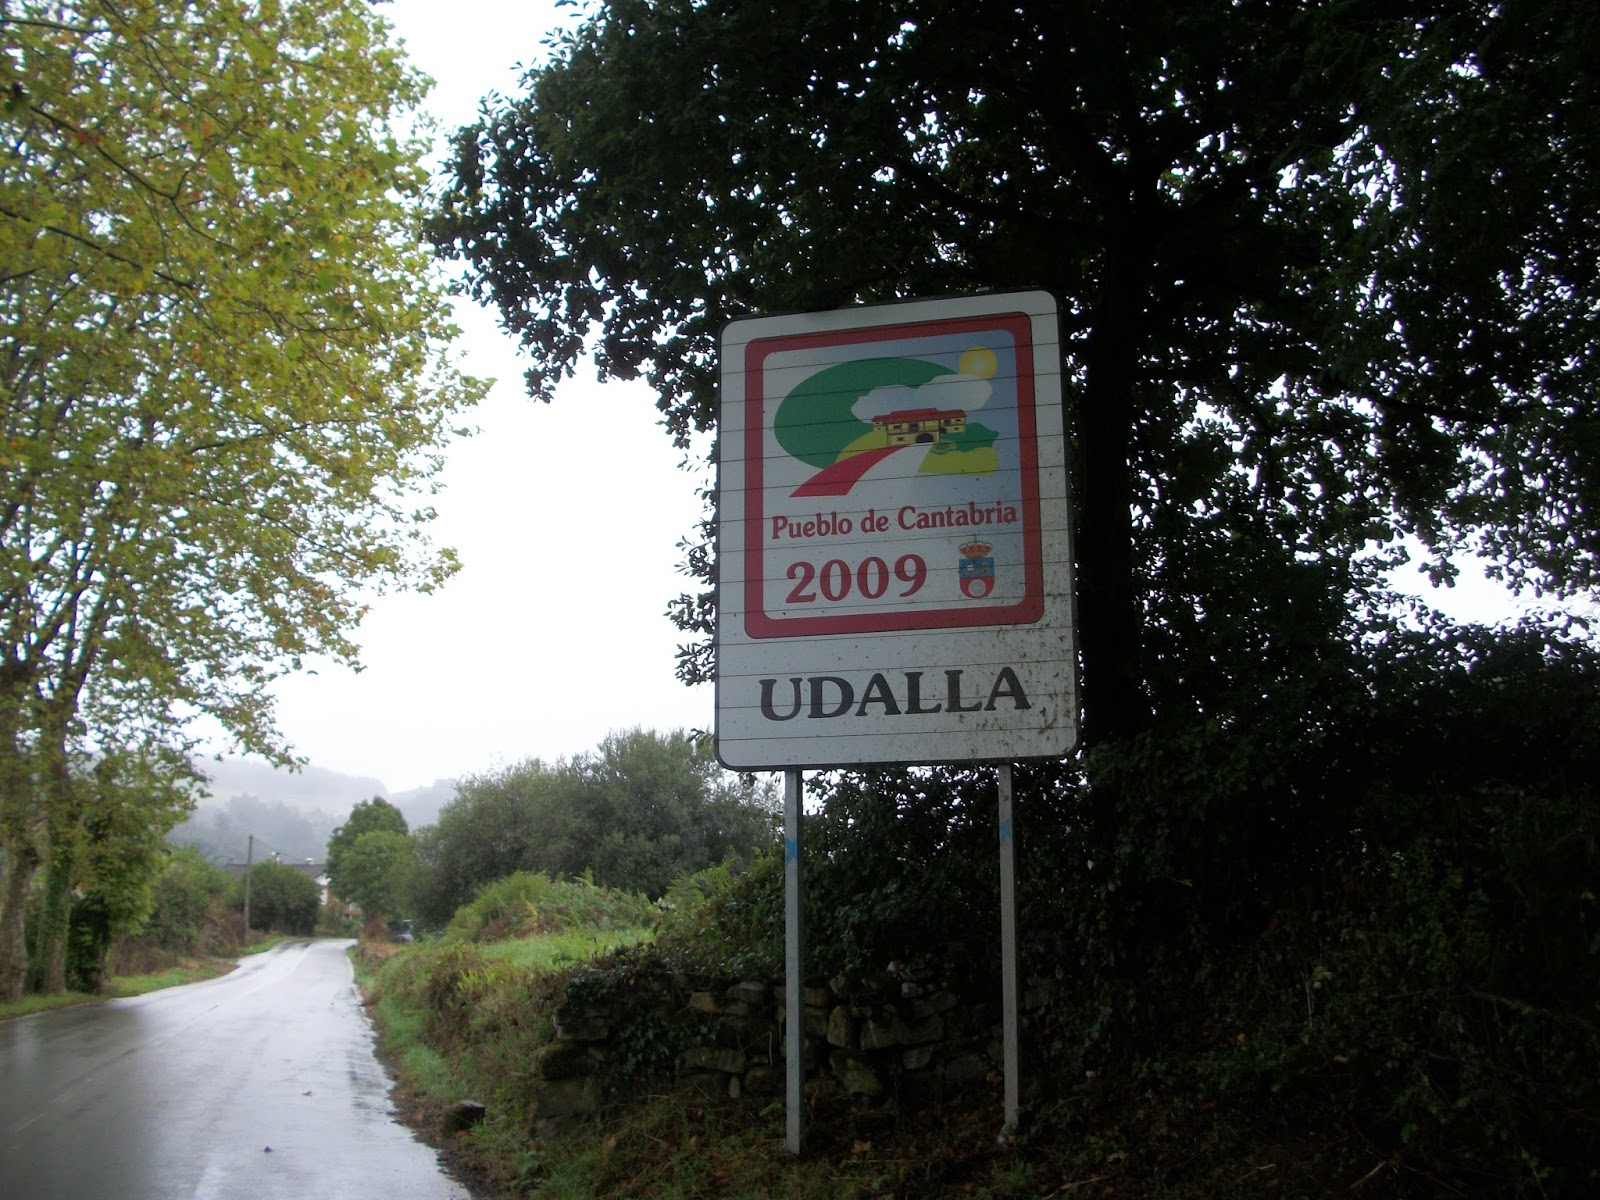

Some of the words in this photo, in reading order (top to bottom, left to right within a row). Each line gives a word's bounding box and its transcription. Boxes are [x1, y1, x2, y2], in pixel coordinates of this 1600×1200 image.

[772, 512, 853, 539] Pueblo
[861, 508, 889, 533] de
[897, 501, 1018, 530] Cantabria
[785, 554, 927, 603] 2009
[759, 666, 1032, 721] UDALLA
